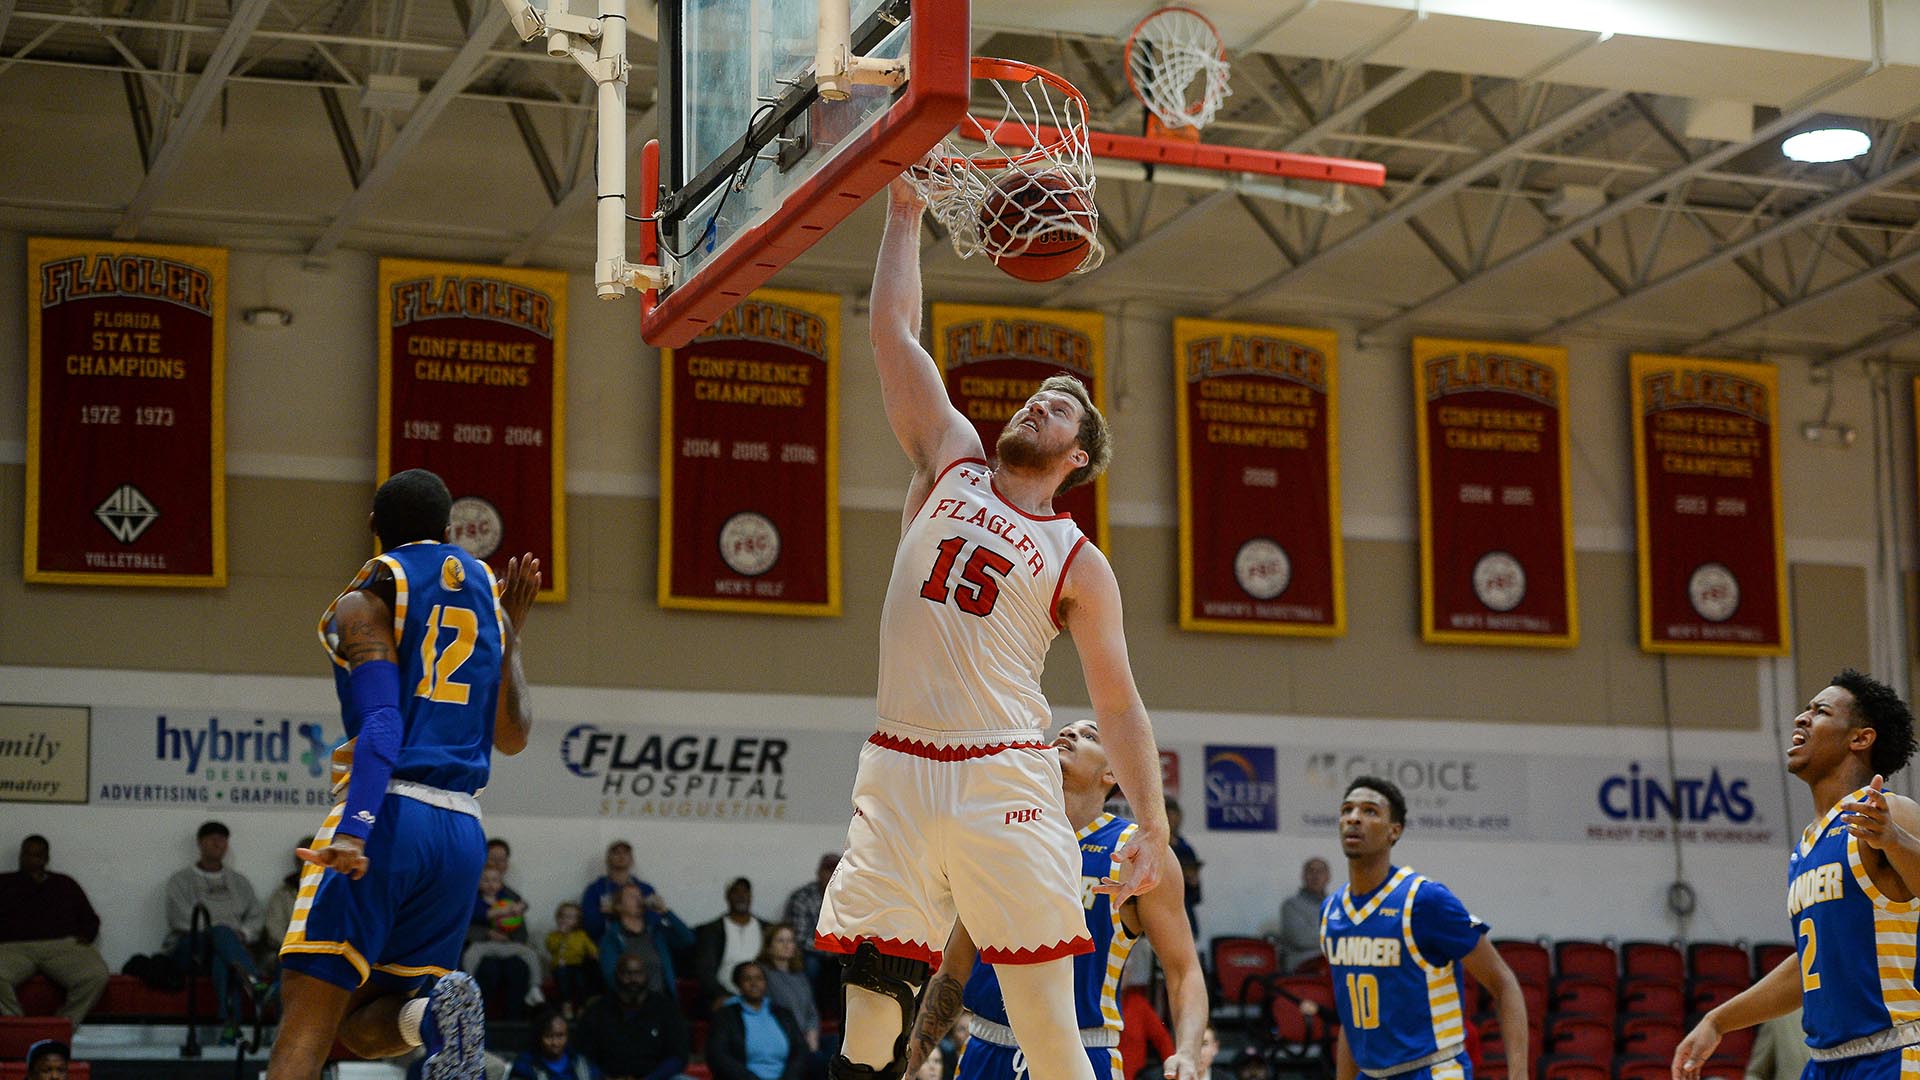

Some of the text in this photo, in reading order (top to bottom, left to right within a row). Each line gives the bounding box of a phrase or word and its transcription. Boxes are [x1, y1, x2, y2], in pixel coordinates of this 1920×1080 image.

[42, 255, 212, 316] FLAGLER
[93, 311, 161, 328] FLORIDA
[391, 277, 552, 339] FLAGLER
[92, 332, 161, 353] STATE
[694, 300, 827, 361] AGLER
[945, 319, 1092, 377] FLAGLER
[66, 355, 186, 379] CHAMPIONS
[408, 336, 536, 364] CONFERENCE
[1187, 336, 1327, 394] FLAGLER
[415, 360, 529, 387] CHAMPIONS
[688, 356, 811, 386] CONFERENCE
[1424, 354, 1559, 409] FLAGLER
[695, 381, 804, 408] CHAMPIONS
[1644, 372, 1770, 425] FLAGLER
[81, 406, 175, 427] 1972 1973
[929, 498, 1045, 577] FLAGLER
[85, 552, 166, 569] VOLLEYBALL
[920, 536, 1015, 617] 15
[415, 604, 479, 705] 12
[156, 715, 290, 775] hybrid
[581, 734, 788, 775] FLAGLER
[206, 768, 288, 782] DESIGN
[601, 774, 787, 800] HOSPITAL
[100, 784, 209, 801] ADVERTISING
[230, 788, 299, 804] GRAPHIC
[1004, 808, 1043, 824] PBC
[1326, 936, 1401, 967] LANDER
[1800, 918, 1821, 992] 2
[1346, 973, 1380, 1030] 10
